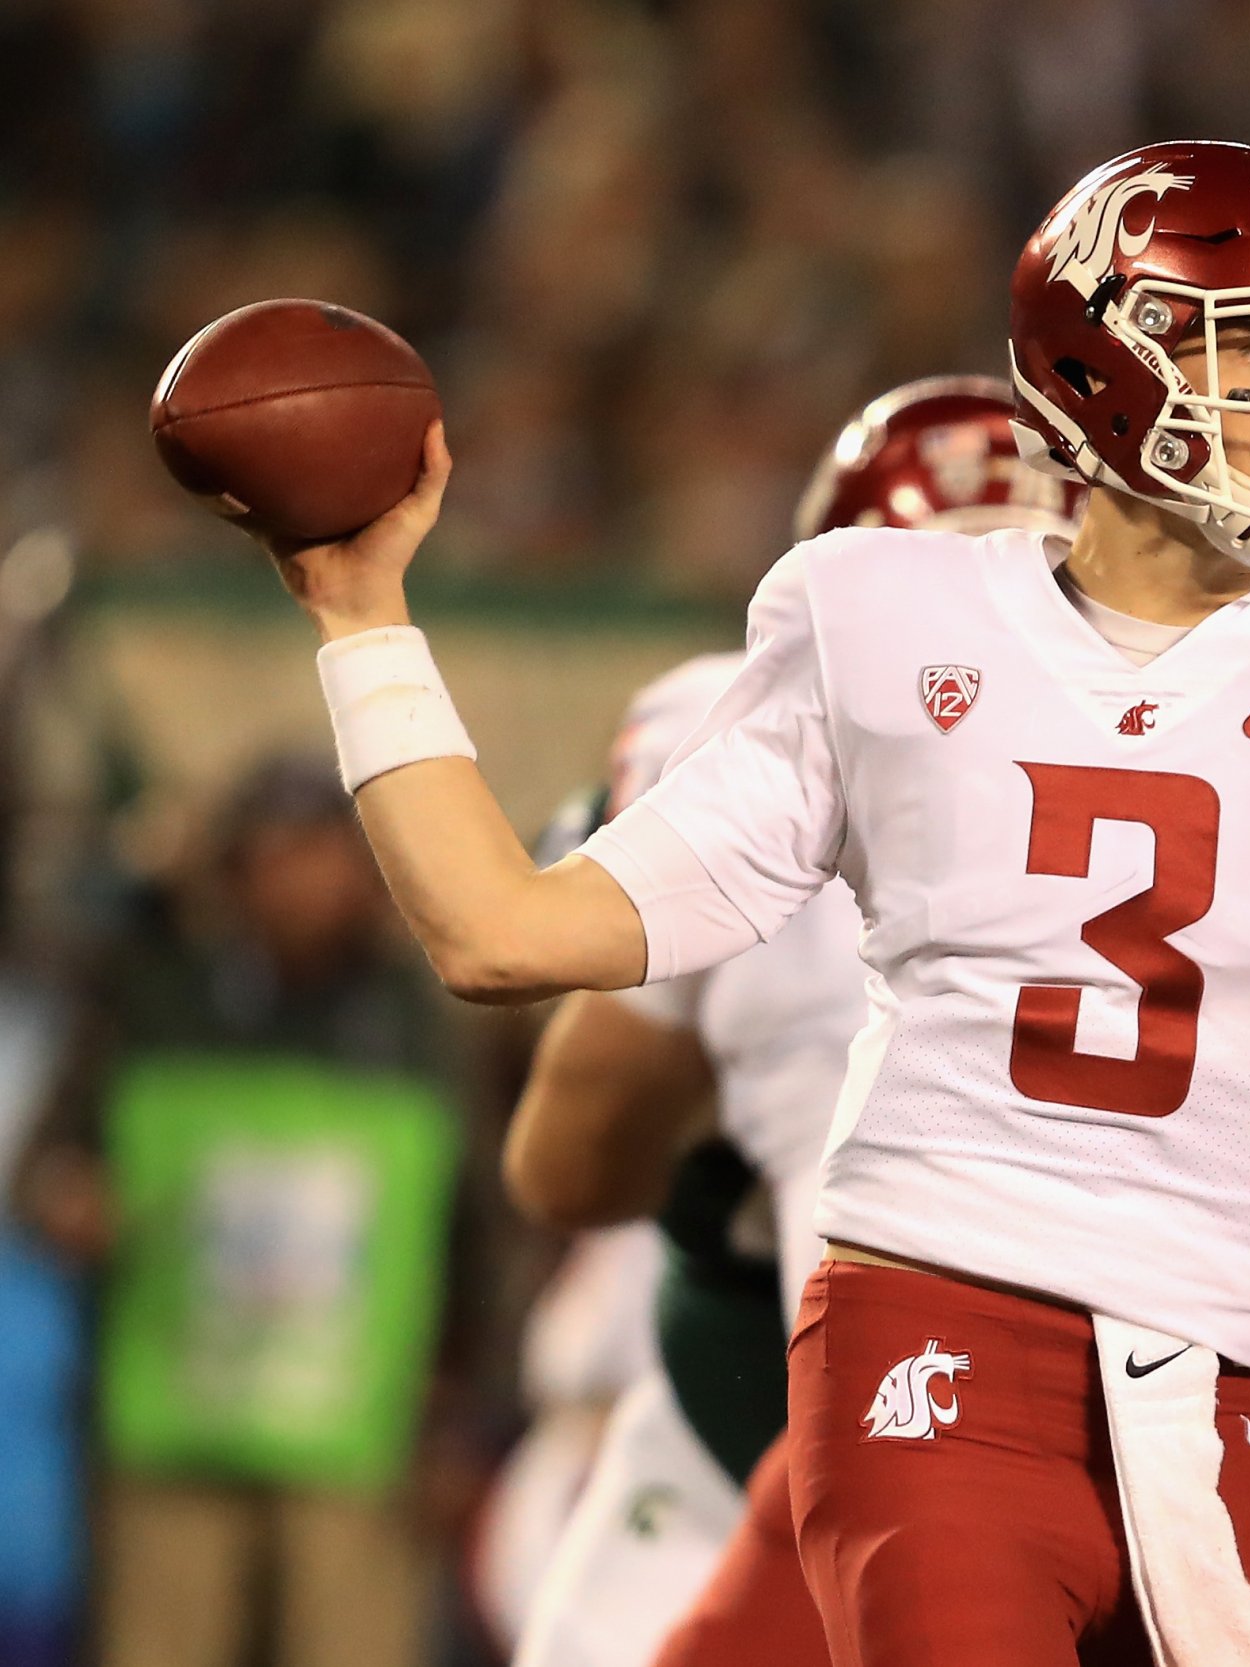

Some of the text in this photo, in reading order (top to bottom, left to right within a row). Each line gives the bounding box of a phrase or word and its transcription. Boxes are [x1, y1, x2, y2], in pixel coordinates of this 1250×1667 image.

[922, 666, 979, 705] PAC
[933, 691, 963, 718] 12
[1010, 759, 1221, 1118] 3
